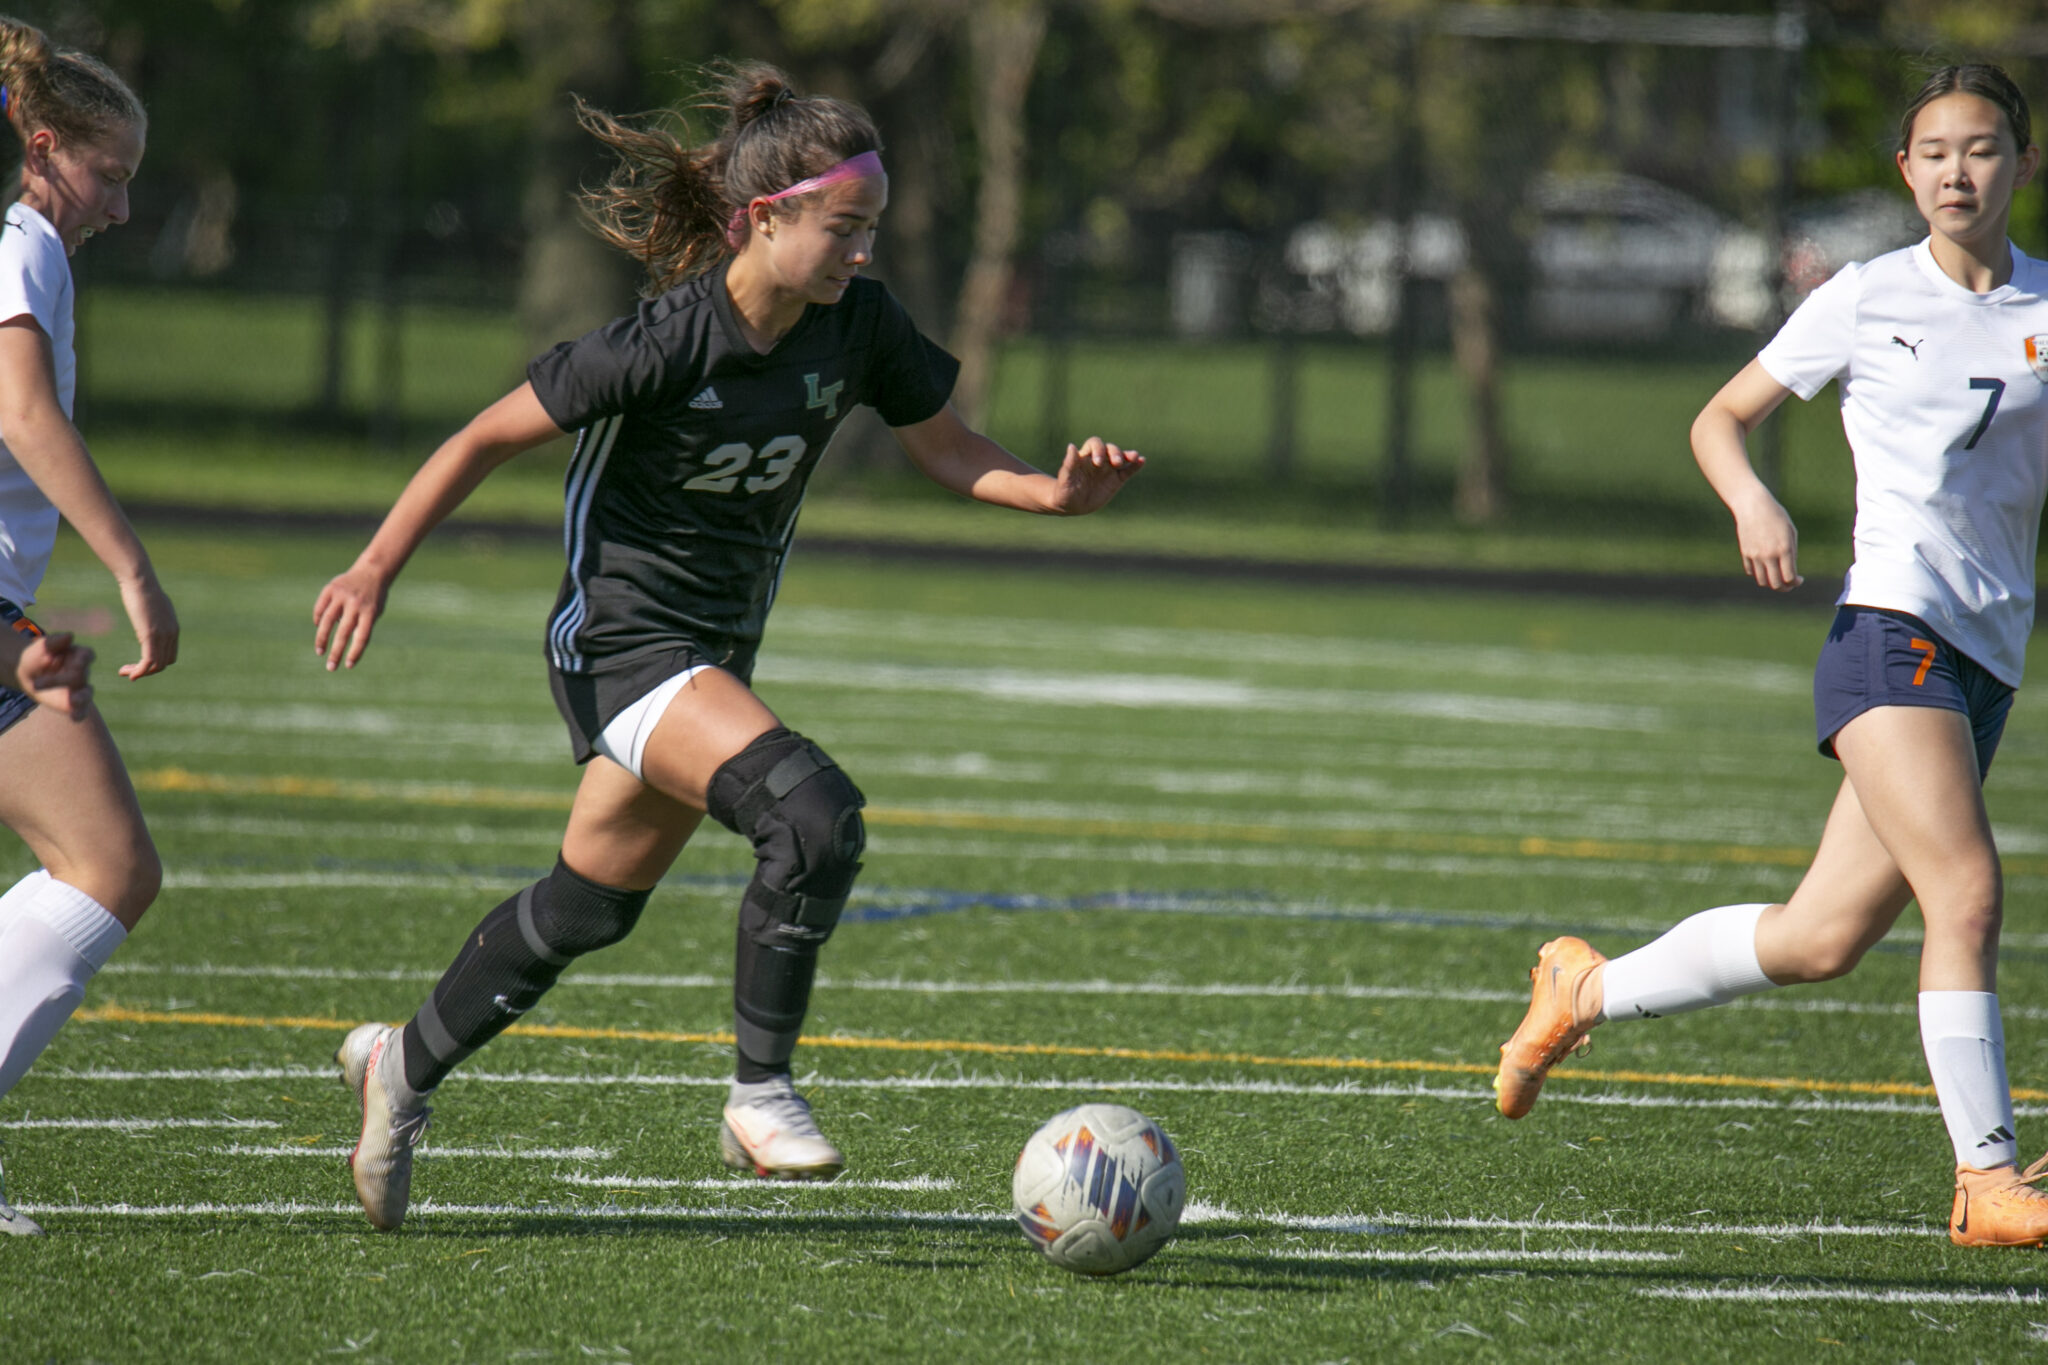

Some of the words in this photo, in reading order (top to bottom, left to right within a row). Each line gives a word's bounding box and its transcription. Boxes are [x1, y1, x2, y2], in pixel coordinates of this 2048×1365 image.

[803, 373, 844, 419] LT
[1964, 377, 2006, 450] 7
[682, 435, 807, 494] 23
[1910, 637, 1937, 686] 7
